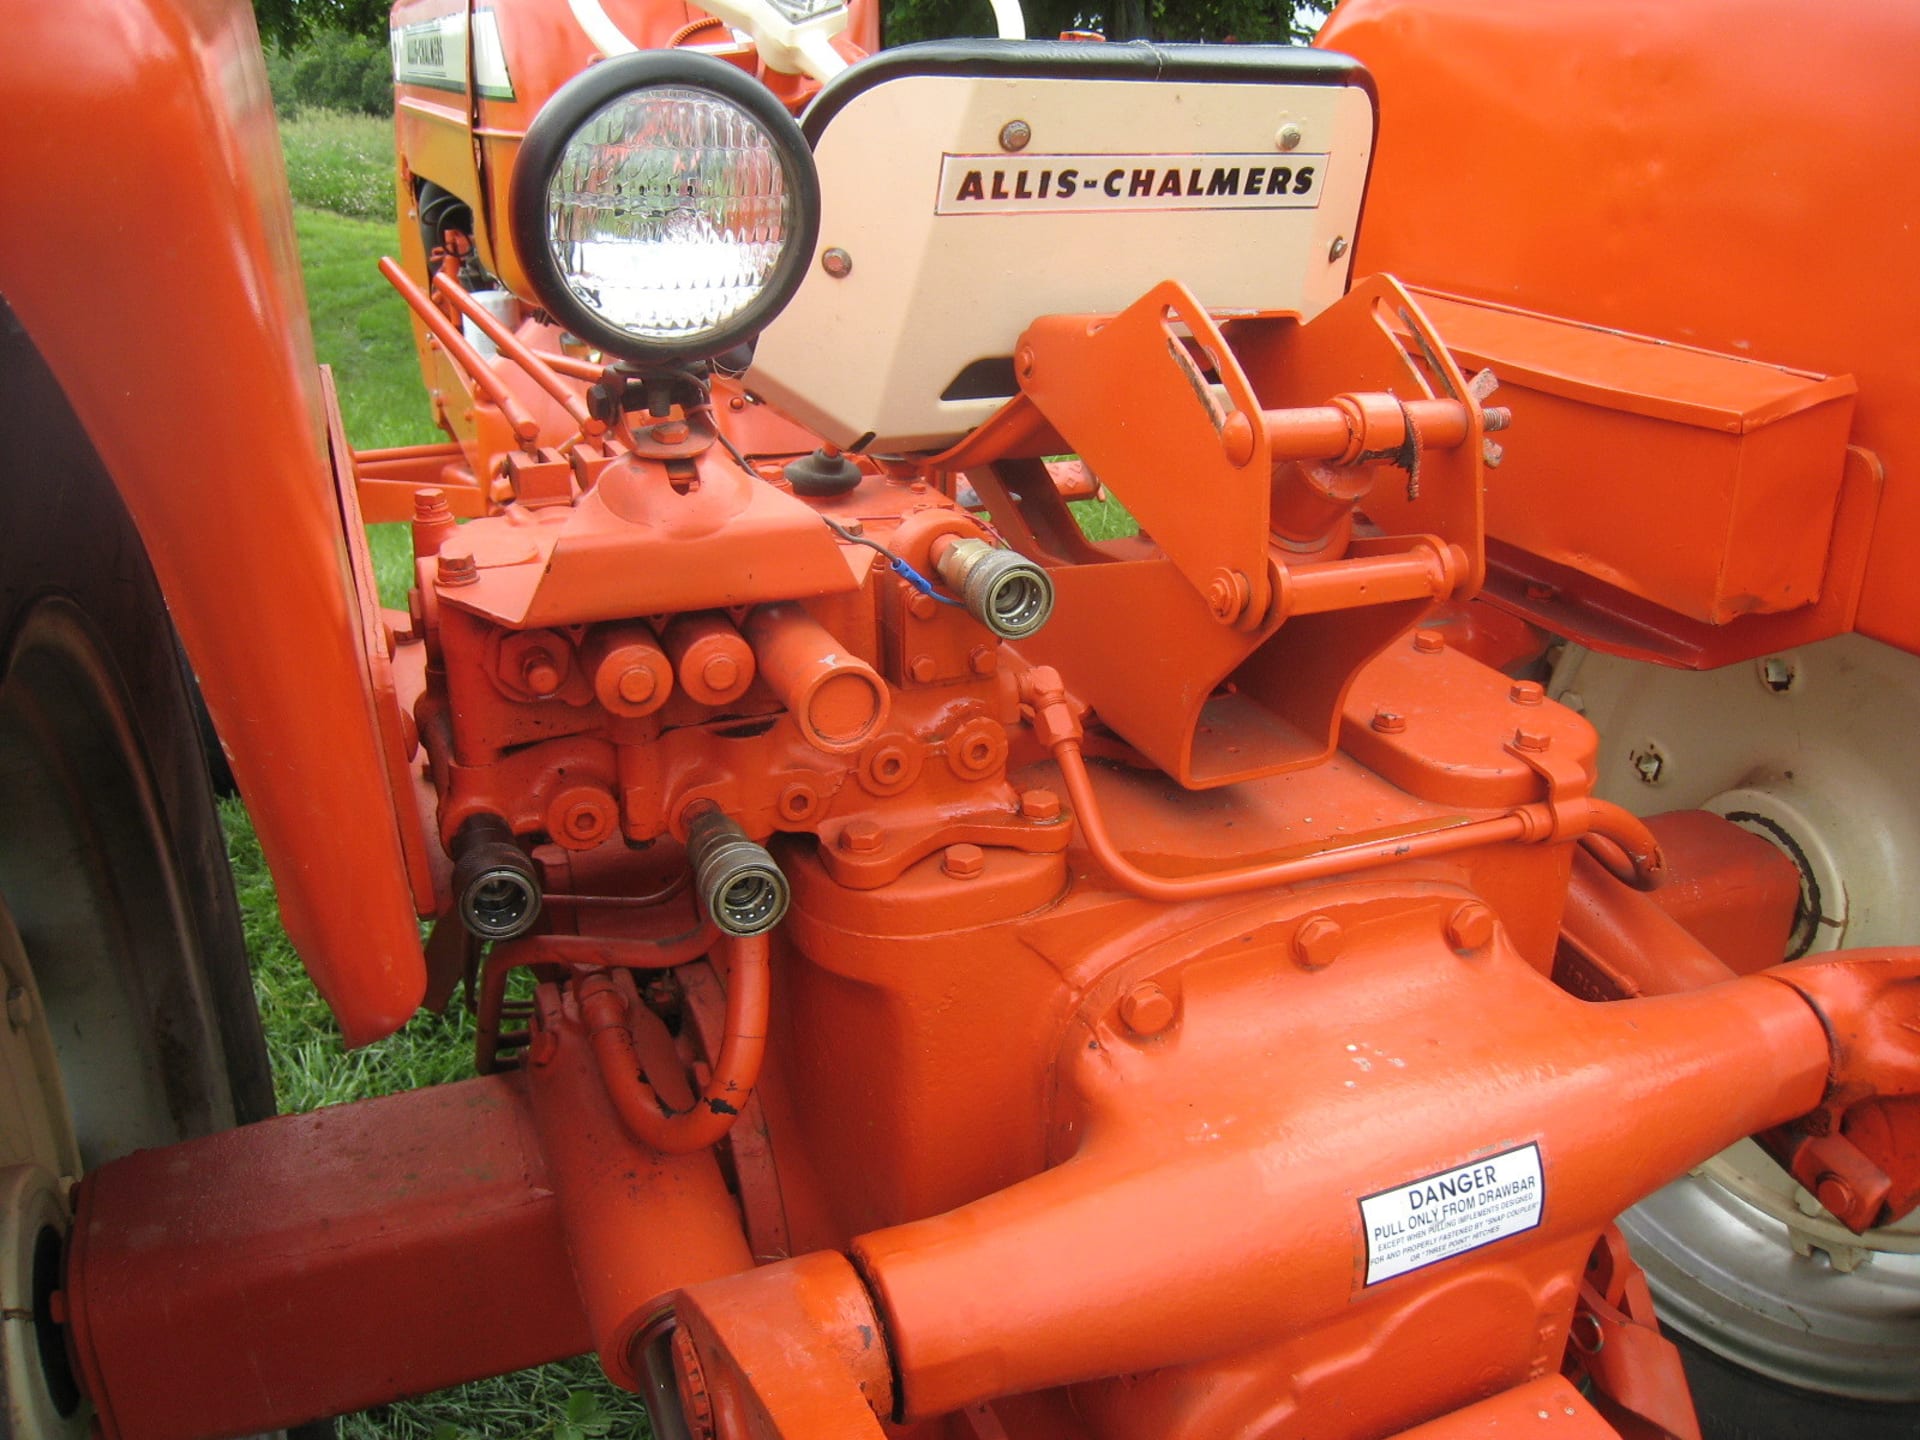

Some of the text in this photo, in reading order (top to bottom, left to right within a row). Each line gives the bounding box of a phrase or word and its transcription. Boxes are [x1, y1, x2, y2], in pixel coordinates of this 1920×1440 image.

[956, 167, 1314, 200] ALLIS-CHALMERS
[1374, 1176, 1536, 1241] PULL ONLY FROM DRAWBAR
[1409, 1165, 1496, 1210] DANGER
[1378, 1192, 1534, 1252] EXCEPT WHEN PULLING IMPLEMENTS DESIGNED
[1371, 1255, 1385, 1266] FOR
[1386, 1249, 1401, 1260] AND
[1402, 1238, 1437, 1255] PROPERLY
[1439, 1224, 1474, 1241] FASTENED
